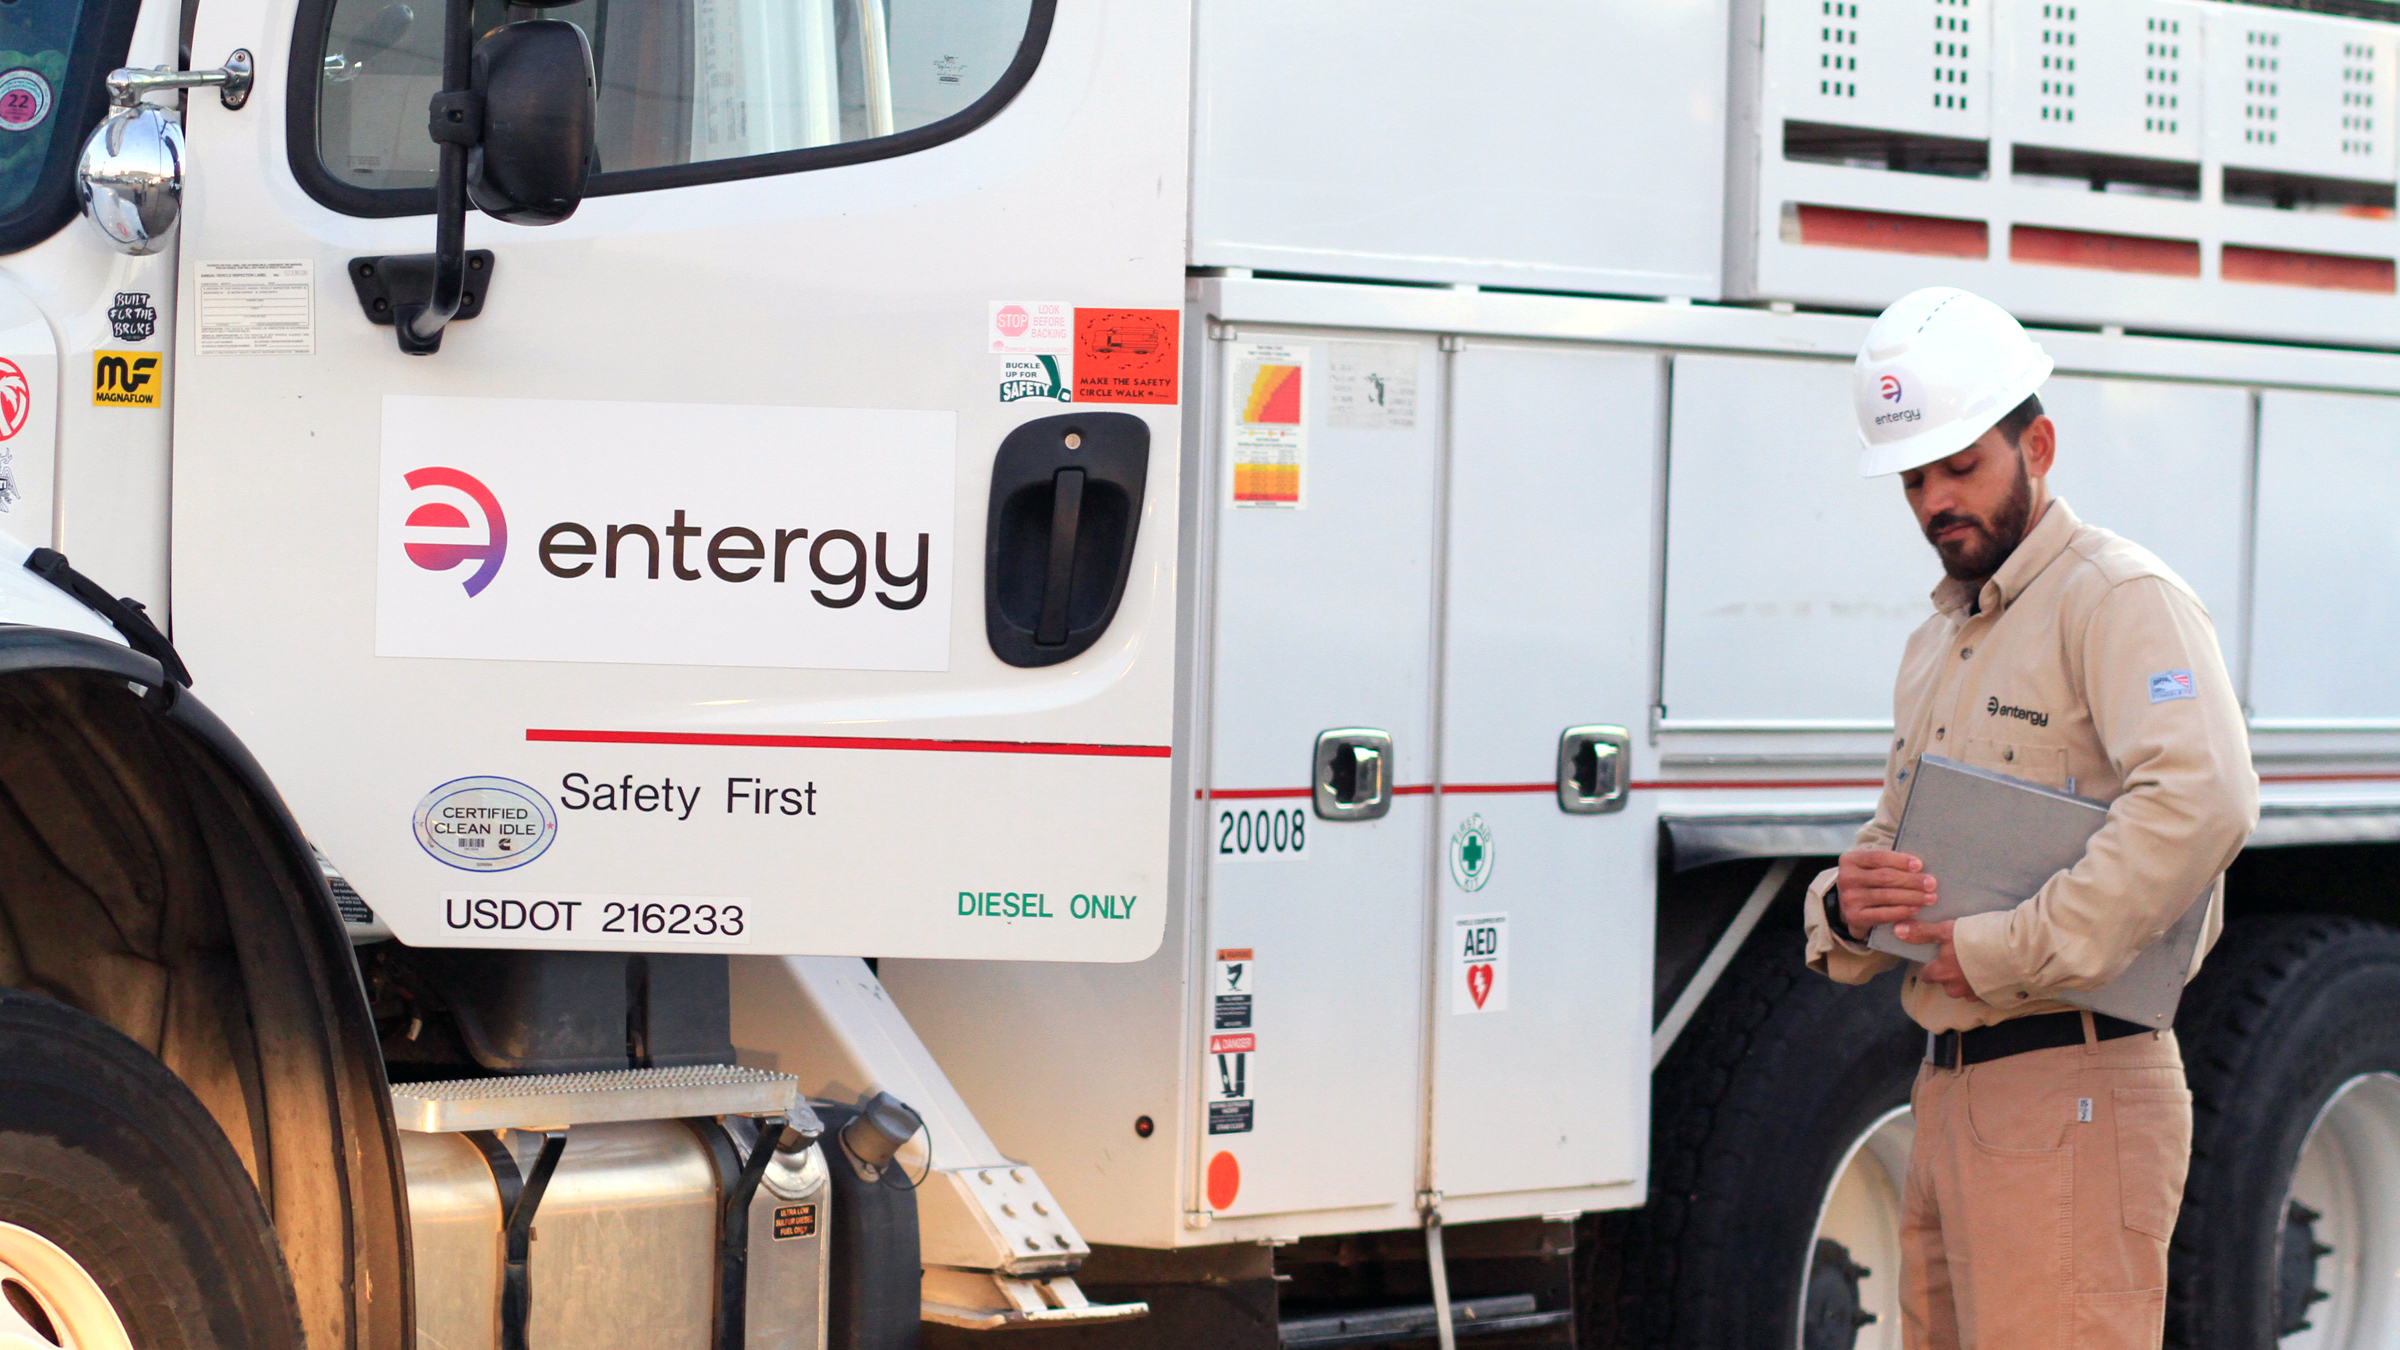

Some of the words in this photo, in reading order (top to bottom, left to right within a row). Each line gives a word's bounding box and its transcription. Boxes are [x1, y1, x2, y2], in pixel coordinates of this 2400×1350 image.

[8, 94, 29, 109] 22
[116, 294, 148, 306] BUILT
[134, 308, 155, 320] THE
[1038, 305, 1060, 314] LOOK
[997, 314, 1028, 328] STOP
[1033, 317, 1065, 327] BEFORE
[1031, 329, 1067, 338] BACKING
[1113, 378, 1130, 386] THE
[1133, 378, 1171, 386] SAFETY
[96, 392, 153, 404] MAGNAFLOW
[1003, 382, 1050, 401] SAFETY
[1079, 389, 1112, 397] CIRCLE
[1116, 389, 1144, 397] WALK
[1875, 408, 1921, 425] entergy
[538, 509, 930, 611] entergy
[1999, 705, 2049, 727] entergy
[560, 772, 702, 821] Safety
[727, 777, 817, 816] First
[442, 807, 528, 819] CERTIFIED
[434, 823, 491, 834] CLEAN
[500, 824, 536, 835] IDLE
[1220, 808, 1305, 854] 20008
[1453, 816, 1477, 844] FIRST
[1478, 822, 1491, 843] AID
[1464, 877, 1478, 888] KIT
[957, 892, 1053, 918] DIESEL
[1069, 894, 1137, 919] ONLY
[445, 899, 582, 932] USDOT
[602, 902, 744, 936] 216233
[1463, 927, 1497, 957] AED
[1222, 1037, 1252, 1049] DANGER
[780, 1208, 796, 1217] ULTRA
